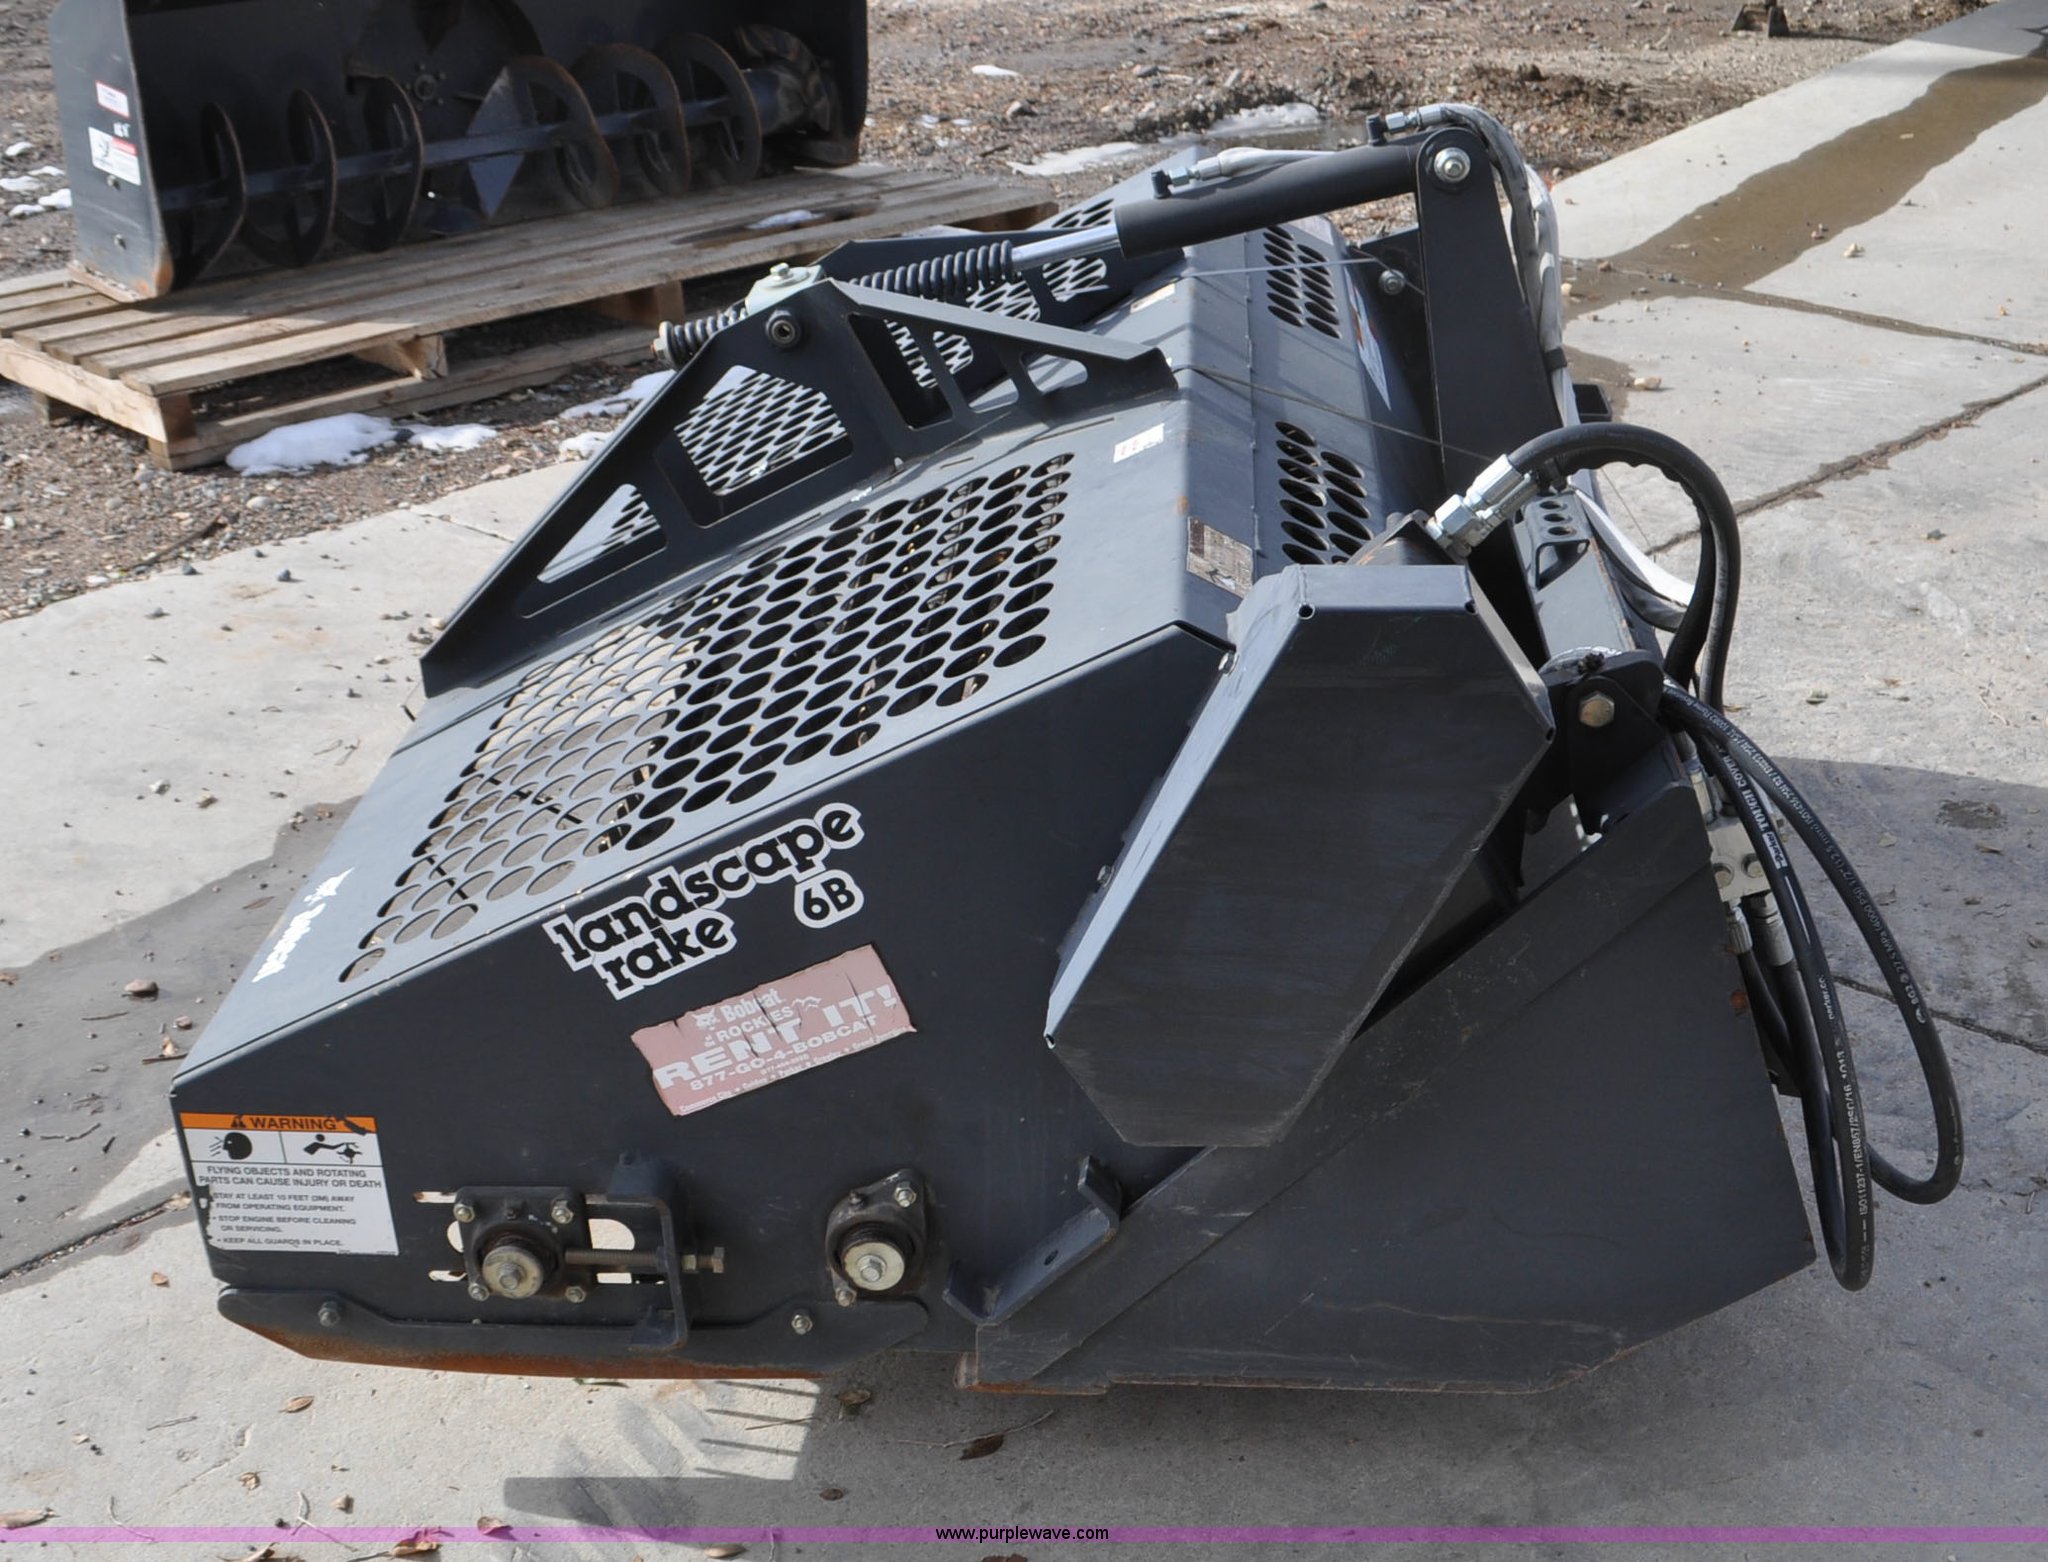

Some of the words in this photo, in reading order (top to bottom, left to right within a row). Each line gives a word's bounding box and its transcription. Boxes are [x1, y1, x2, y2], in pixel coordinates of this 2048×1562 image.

[554, 809, 857, 965] landscape
[800, 874, 858, 923] 6B
[601, 916, 730, 992] rake
[653, 1018, 801, 1089] RENT
[822, 984, 897, 1027] IT!
[690, 1014, 877, 1091] 877-GO-4-BOBCAT
[249, 1116, 337, 1130] WARNING
[198, 1175, 230, 1184] PARTS
[232, 1176, 254, 1185] CAN
[256, 1177, 291, 1186] CAUSE
[292, 1178, 329, 1187] INJURY
[331, 1179, 347, 1187] OR
[348, 1180, 382, 1188] DEATH
[207, 1166, 241, 1175] FLYING
[243, 1166, 290, 1176] OBJECTS
[292, 1168, 314, 1177] AND
[316, 1168, 366, 1178] ROTATING
